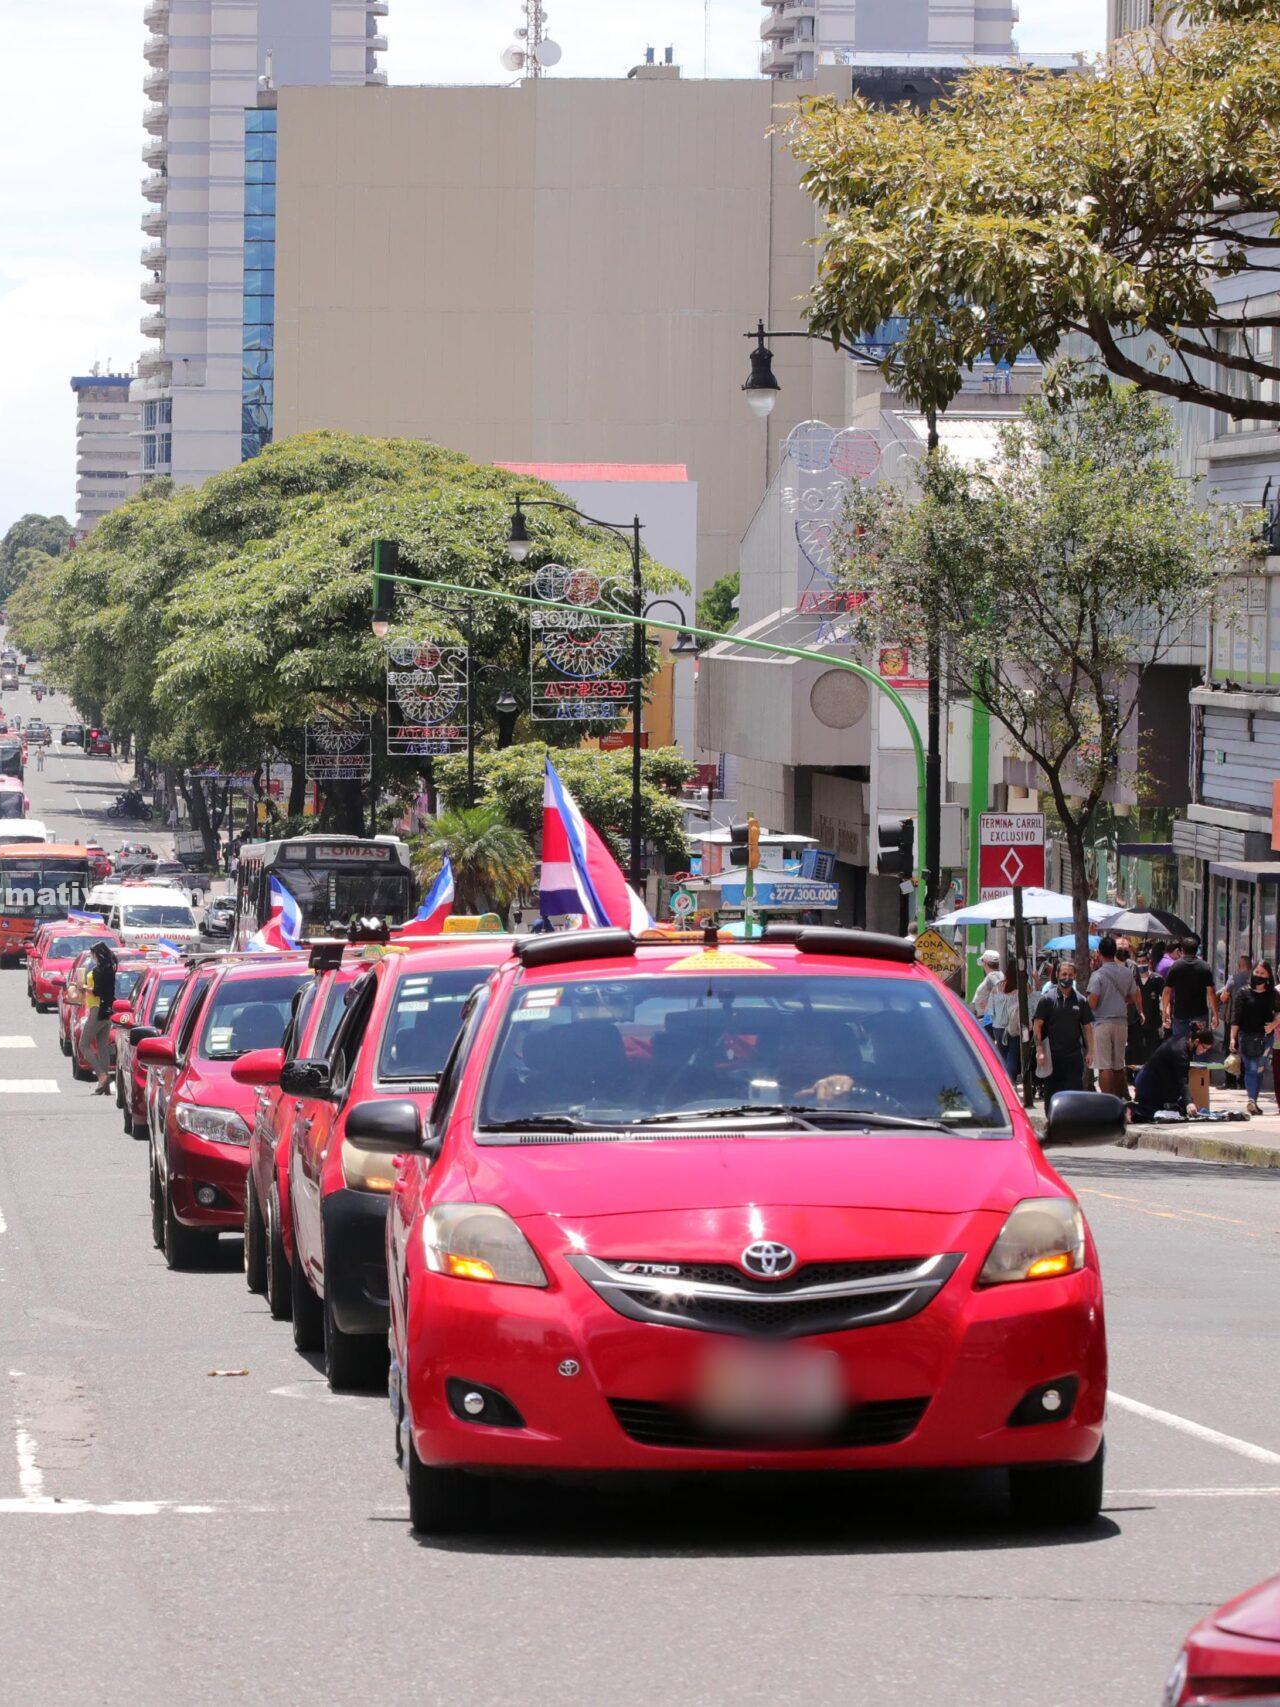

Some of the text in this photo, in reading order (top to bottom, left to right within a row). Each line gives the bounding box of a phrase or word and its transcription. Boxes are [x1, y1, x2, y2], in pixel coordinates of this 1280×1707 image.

[982, 818, 1043, 828] TERMINA CARRIL
[990, 831, 1036, 842] EXCLUSIVO
[320, 845, 387, 858] LOMAS
[917, 940, 943, 948] ZONA
[922, 952, 936, 960] DE
[640, 1263, 680, 1275] TRD
